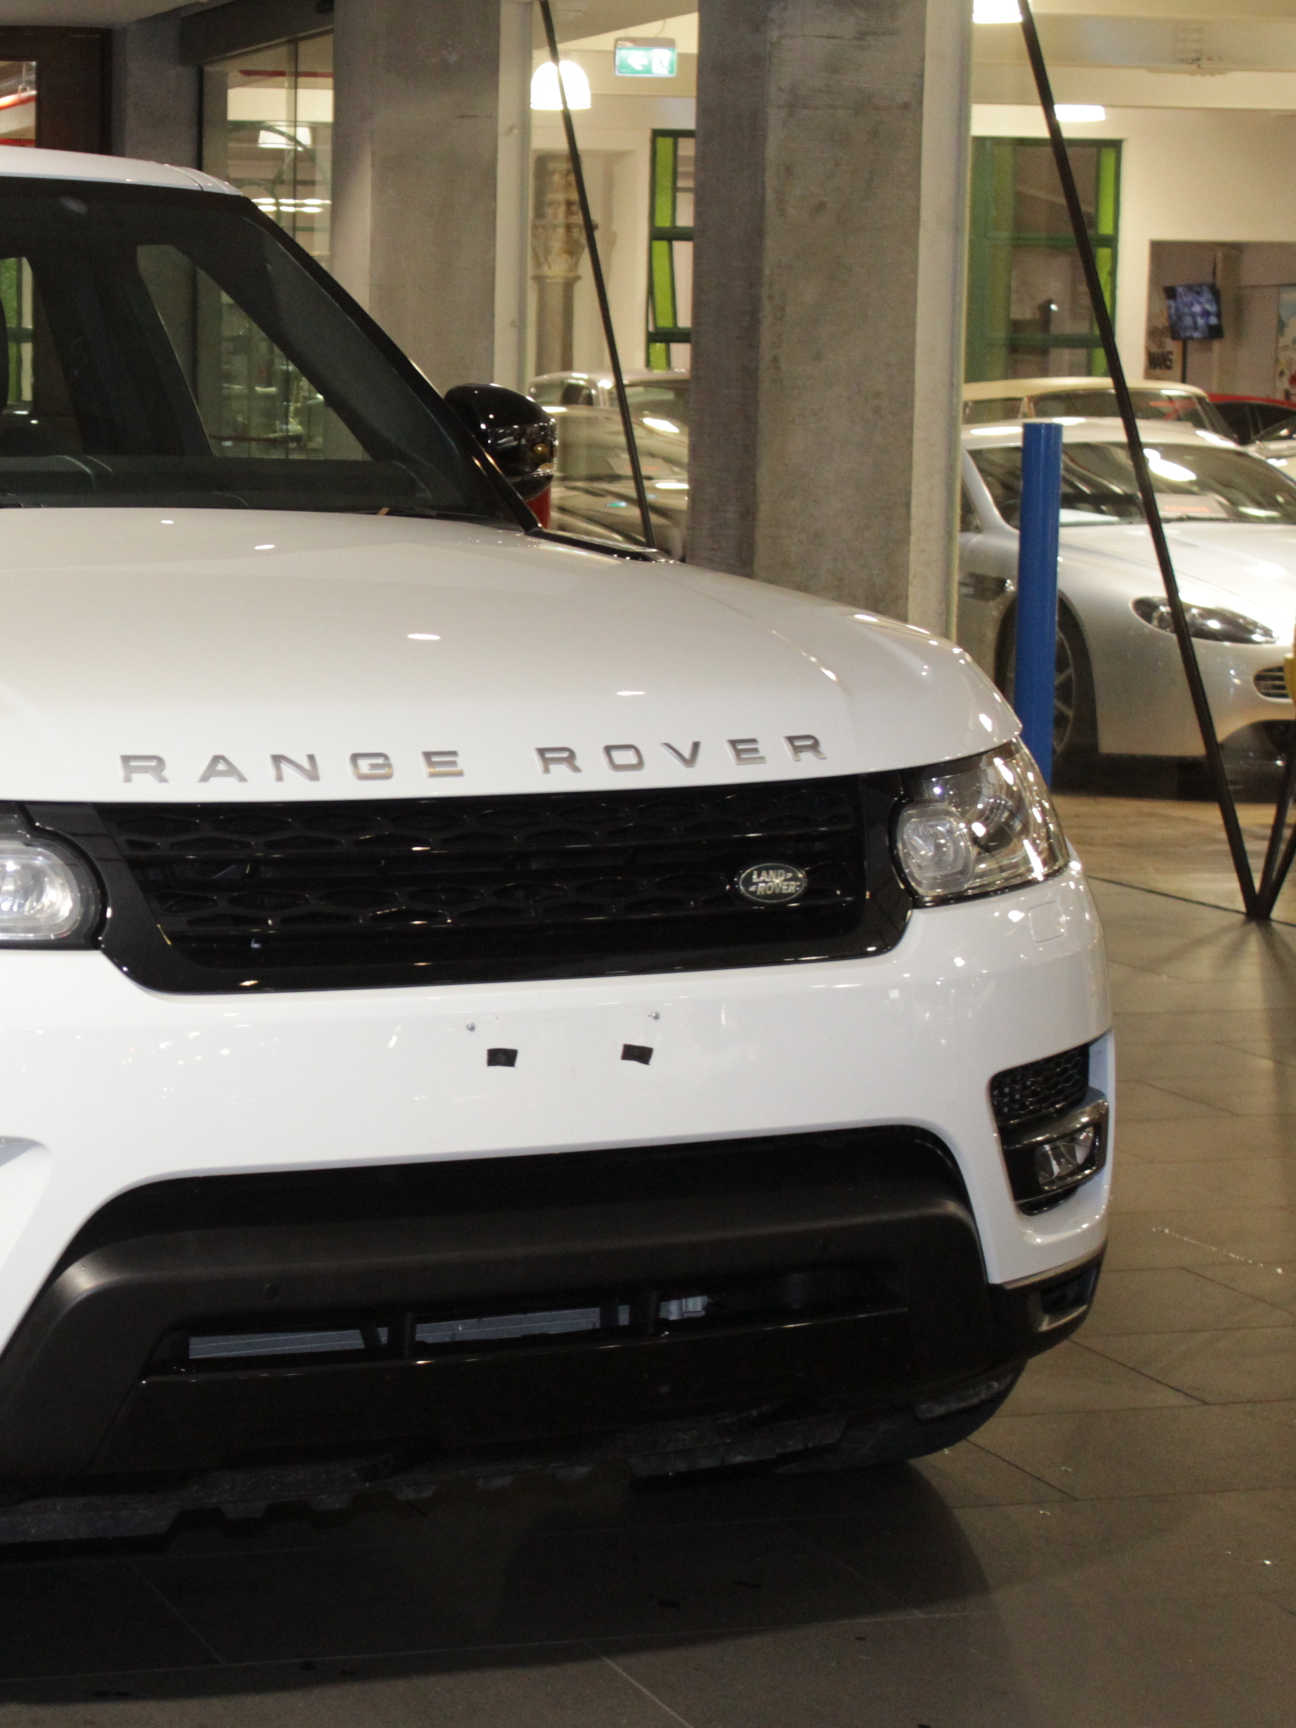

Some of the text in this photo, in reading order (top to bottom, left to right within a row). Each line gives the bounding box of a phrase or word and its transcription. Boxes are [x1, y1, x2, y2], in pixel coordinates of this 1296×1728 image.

[120, 734, 827, 783] RANGE ROVER
[752, 869, 785, 882] LAND
[756, 881, 797, 895] ROVER
